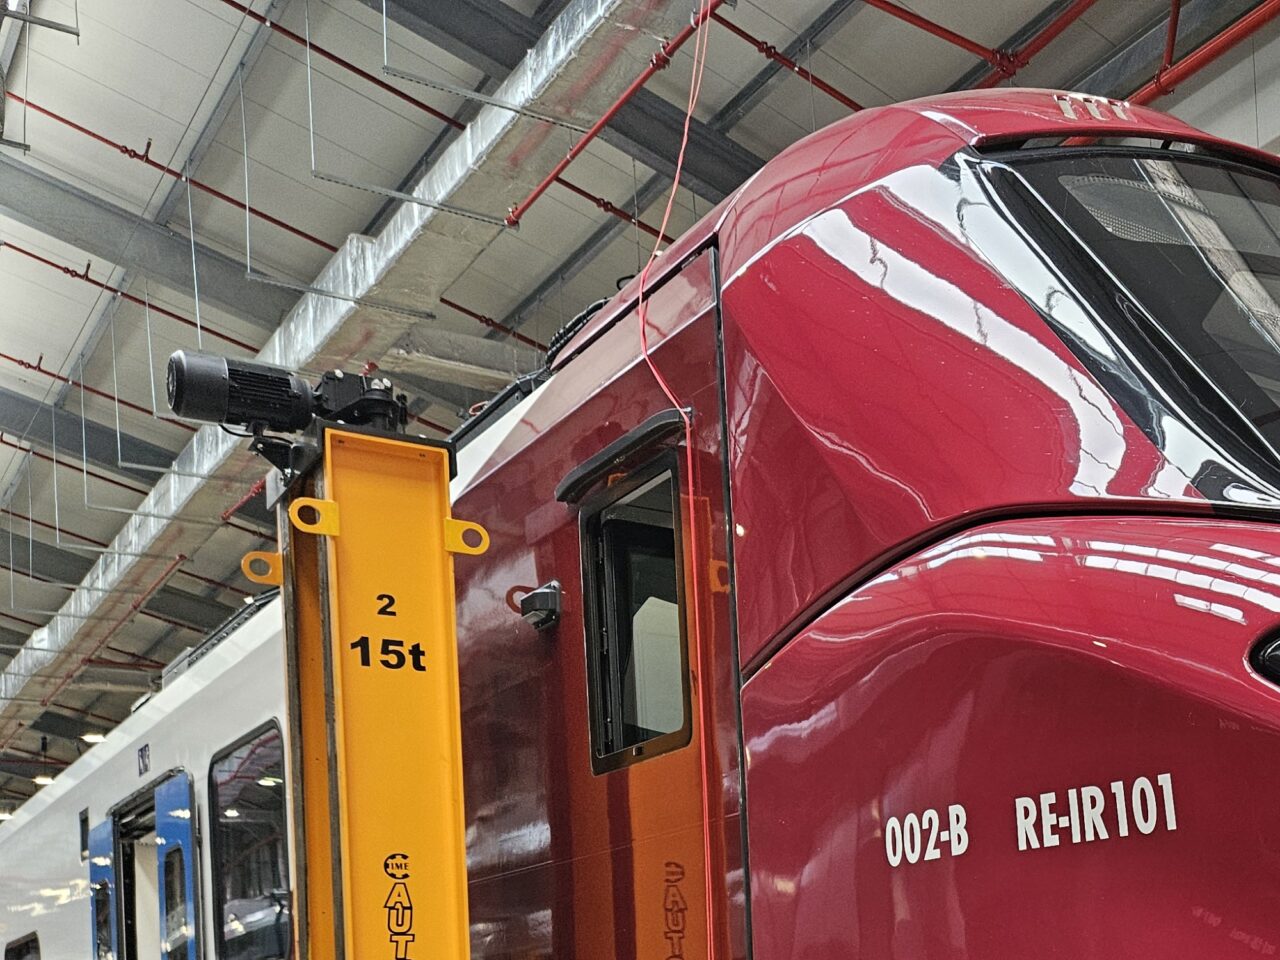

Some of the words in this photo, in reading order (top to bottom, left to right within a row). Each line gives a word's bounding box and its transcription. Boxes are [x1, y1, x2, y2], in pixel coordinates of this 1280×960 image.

[377, 594, 396, 616] 2
[351, 637, 426, 671] 15t
[886, 805, 968, 866] 002-B
